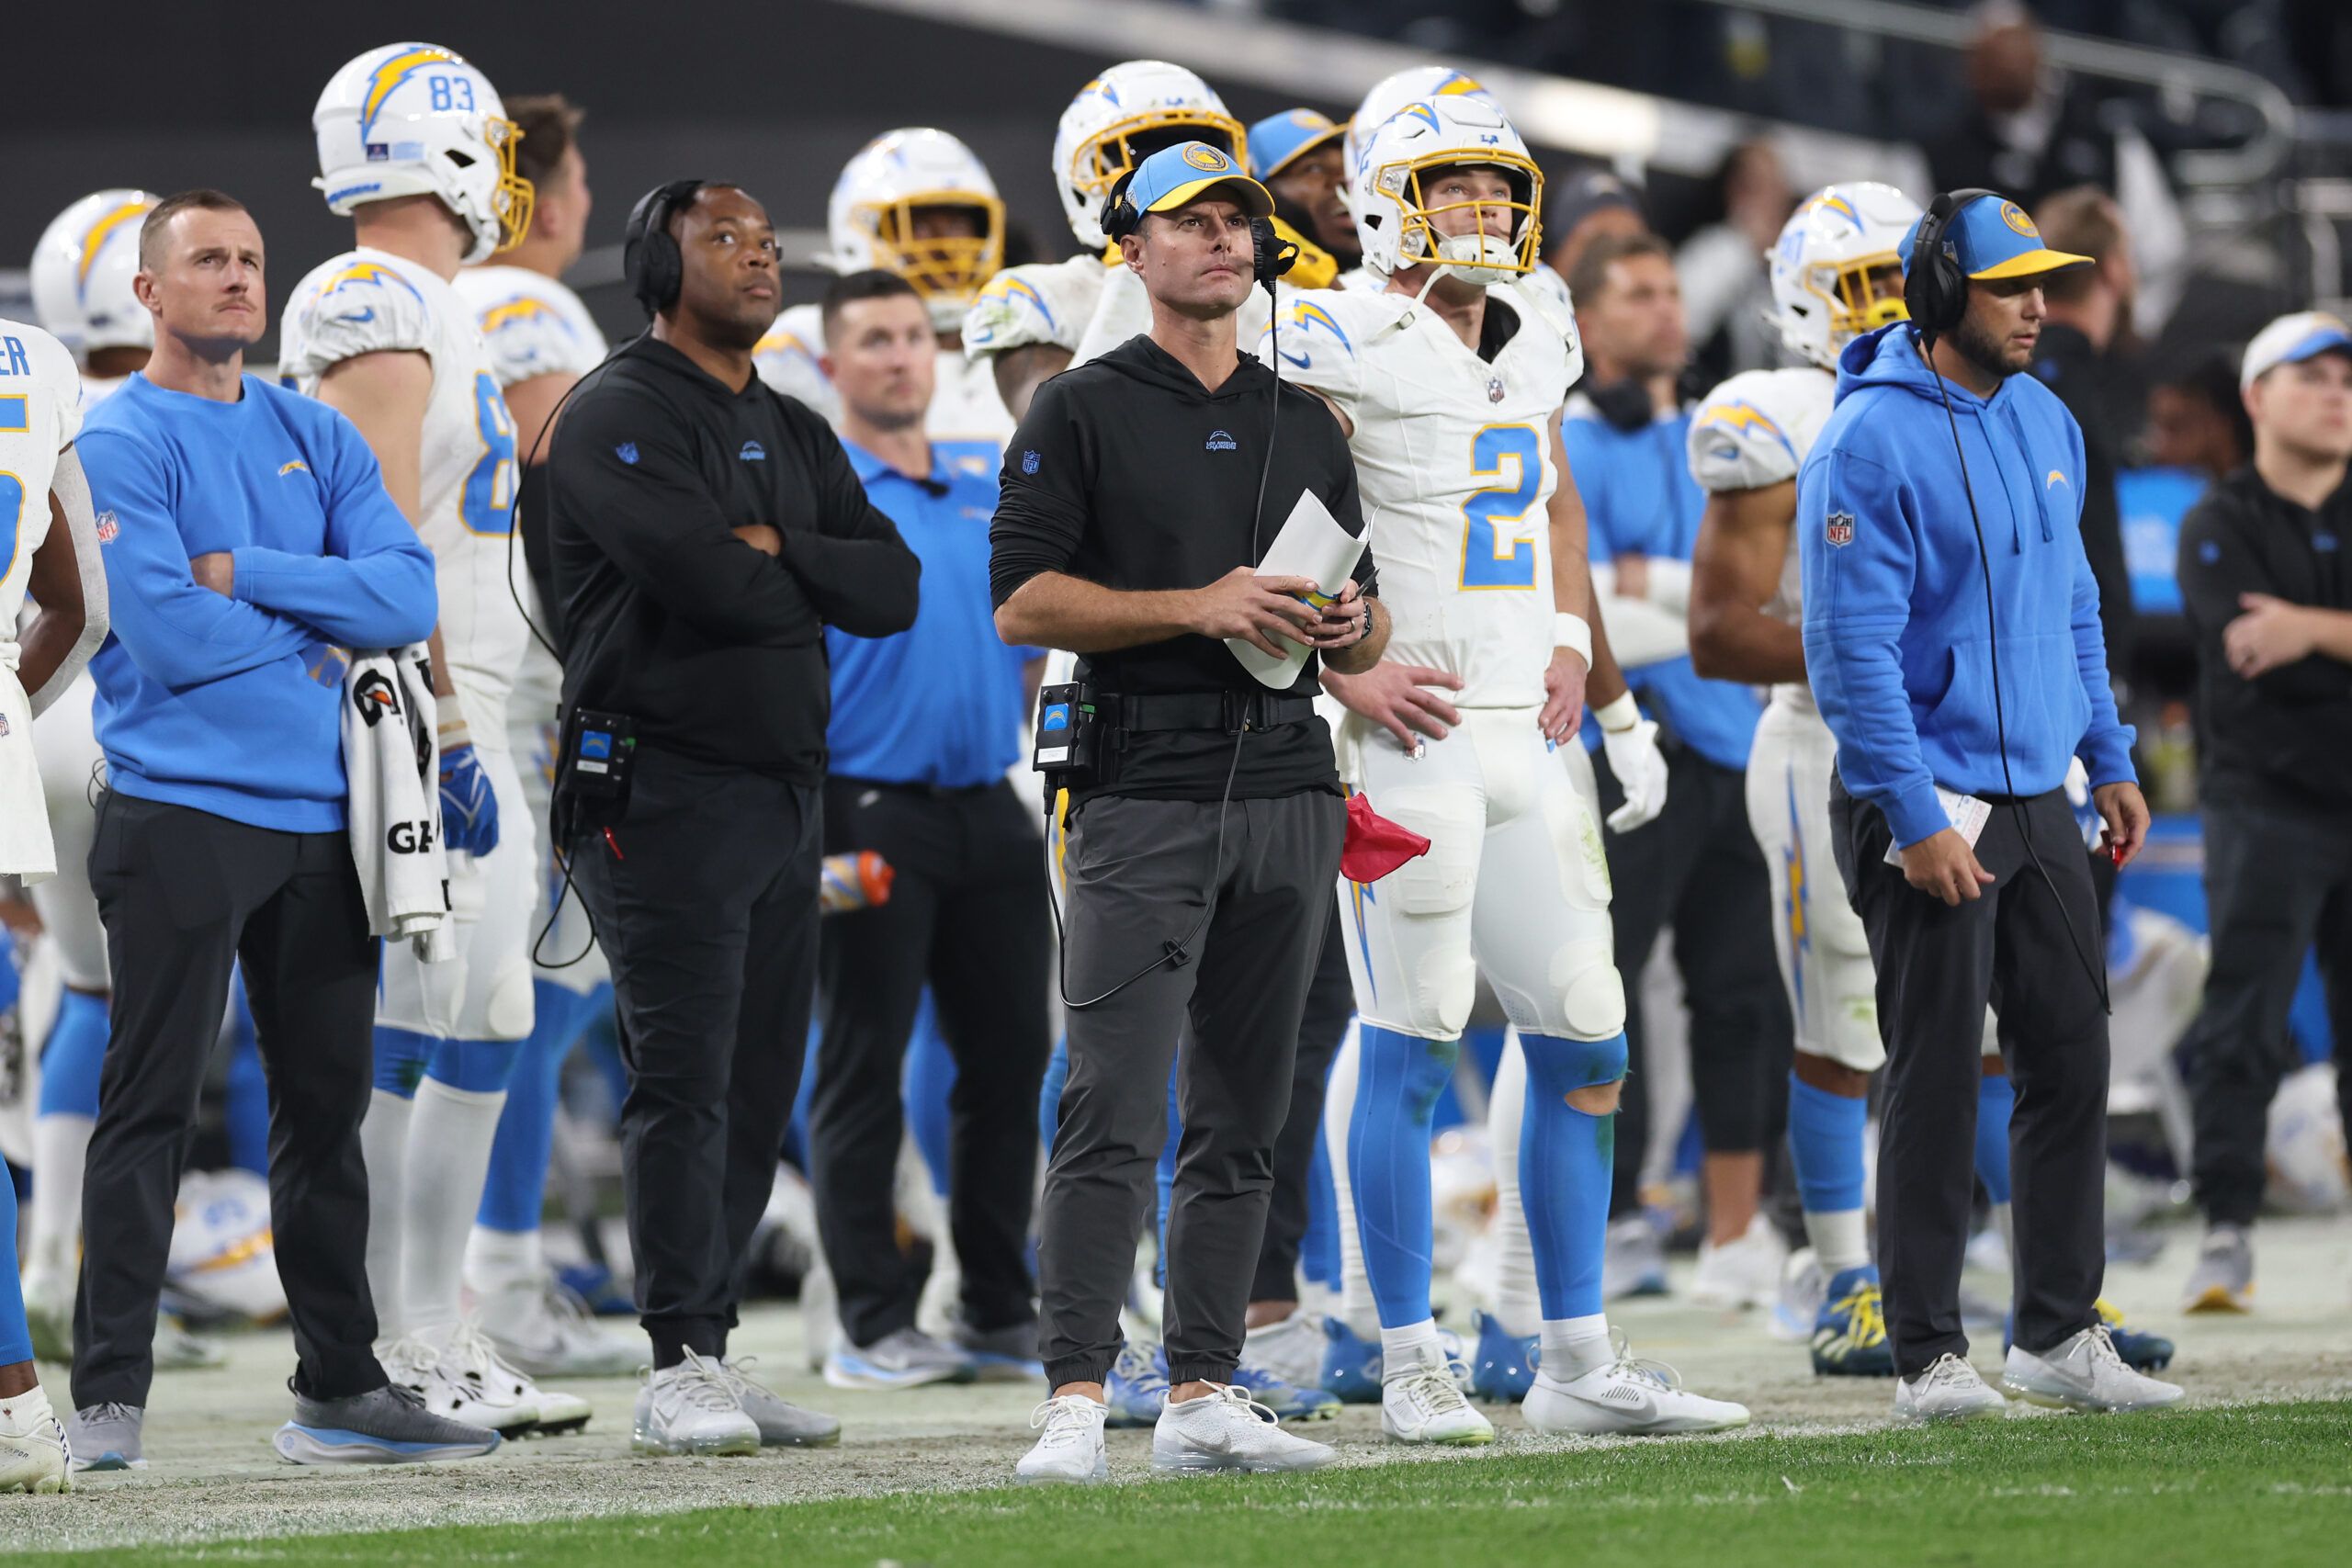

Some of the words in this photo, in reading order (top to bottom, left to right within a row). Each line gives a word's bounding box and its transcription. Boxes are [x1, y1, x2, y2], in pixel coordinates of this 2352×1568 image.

[429, 76, 474, 112] 83
[1458, 423, 1544, 592] 2
[97, 523, 119, 541] NFL
[1829, 526, 1850, 541] NFL
